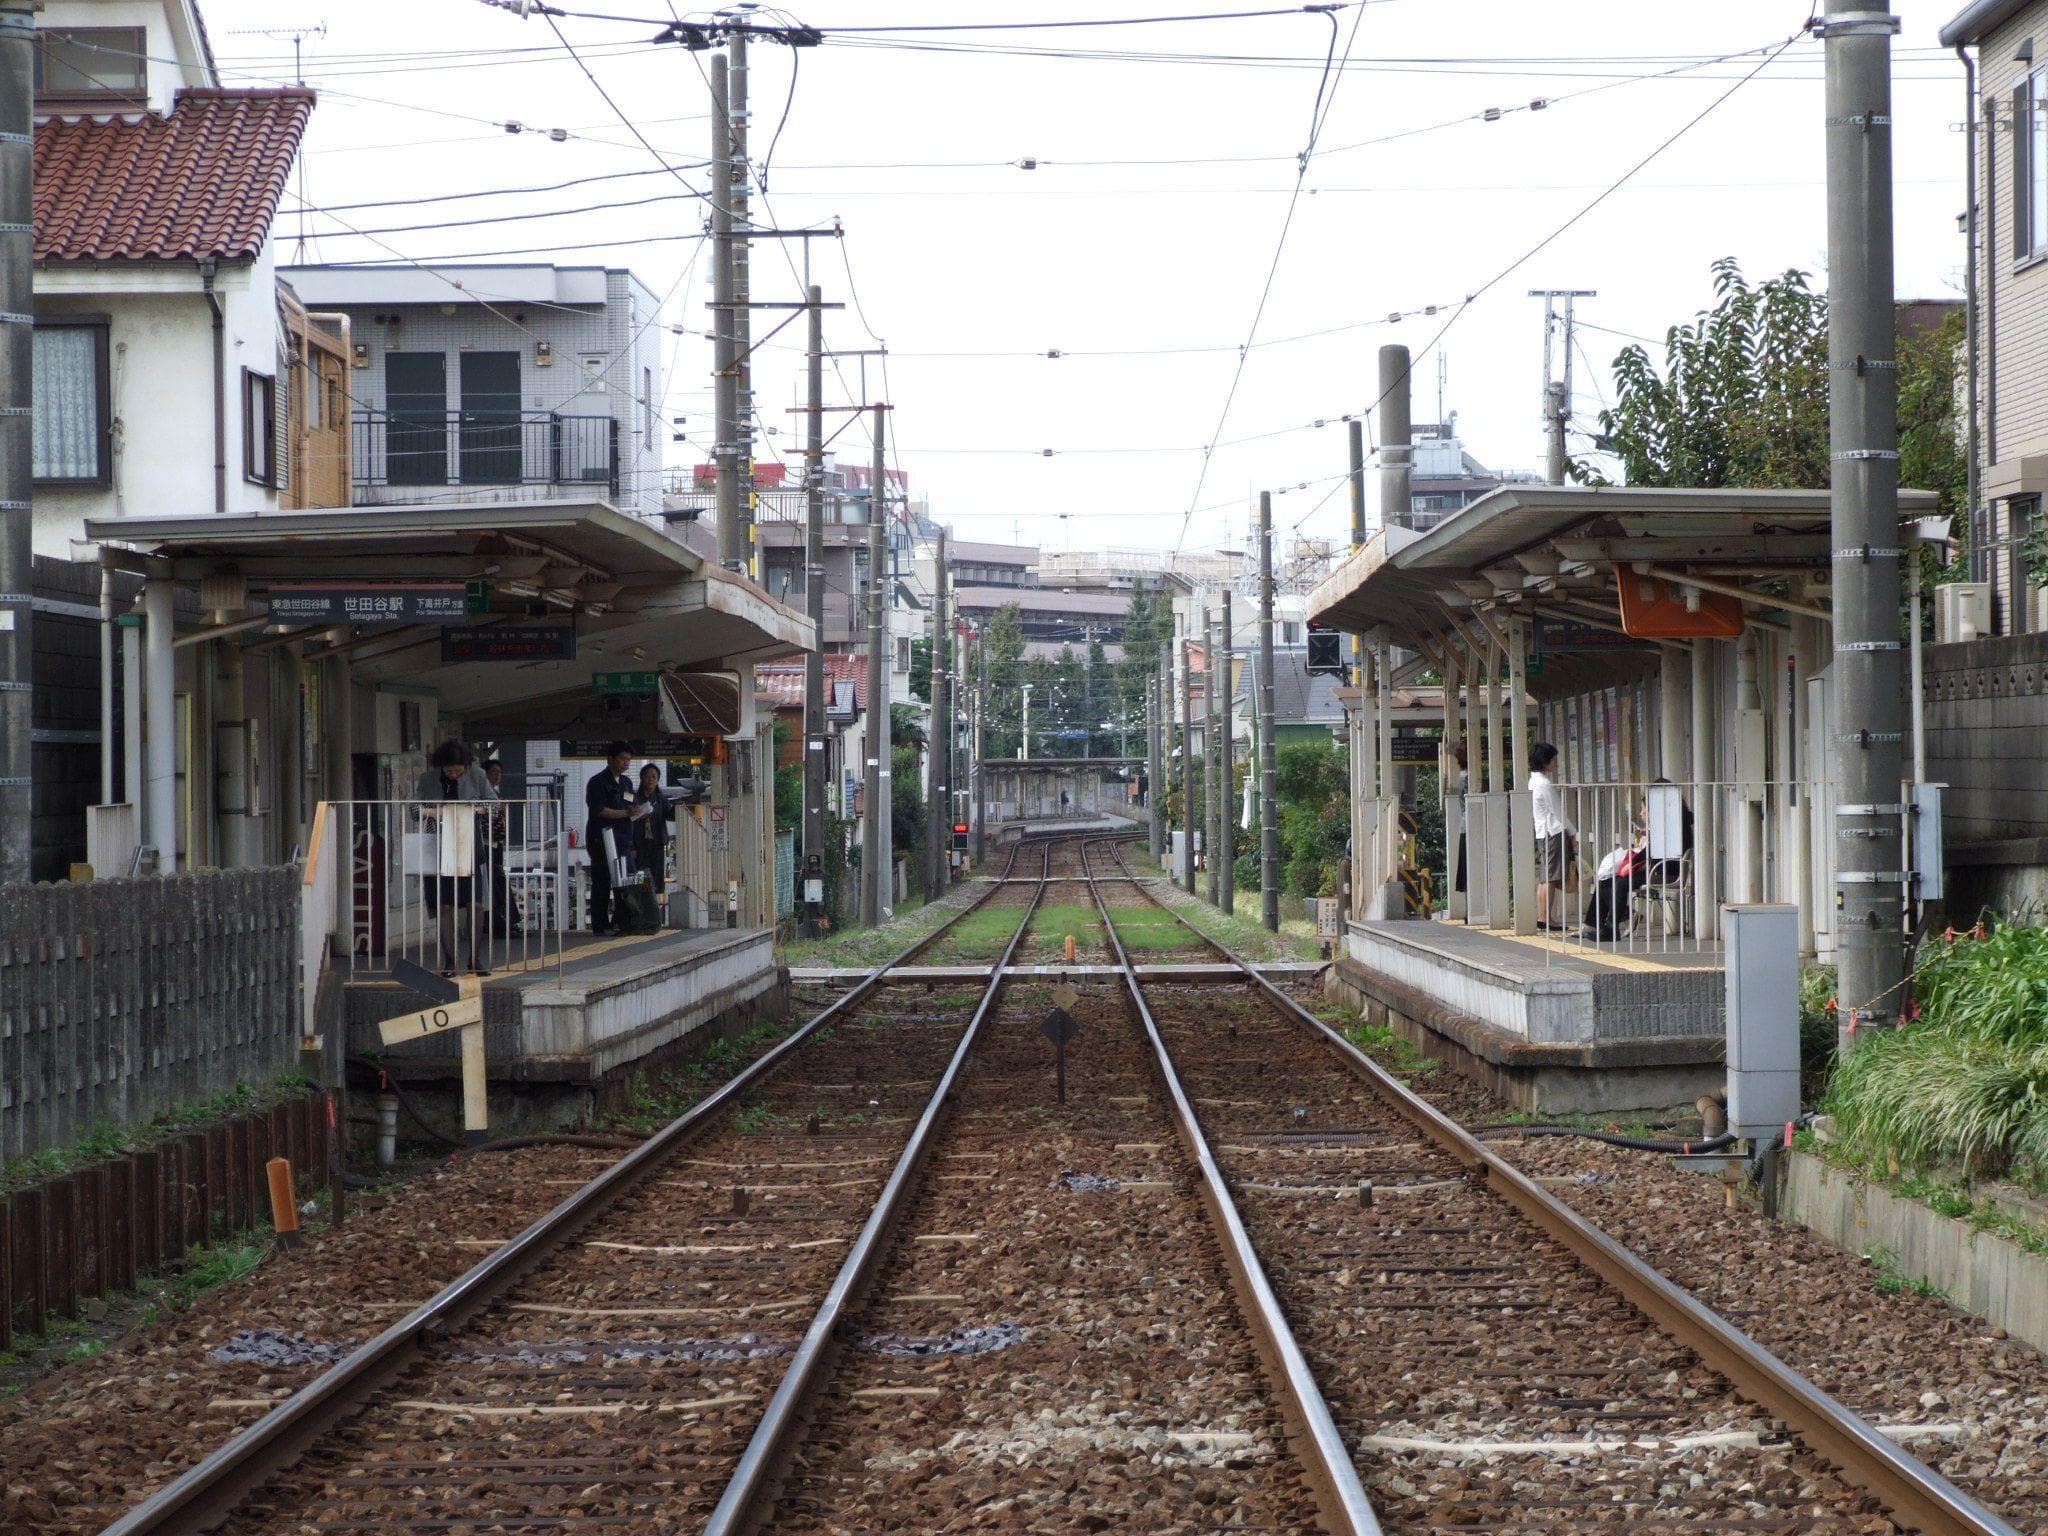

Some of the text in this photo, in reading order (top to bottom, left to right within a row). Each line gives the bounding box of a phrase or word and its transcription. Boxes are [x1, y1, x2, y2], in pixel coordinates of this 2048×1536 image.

[272, 599, 330, 610] 東急世田谷線
[344, 597, 403, 611] 世田谷駅
[350, 612, 399, 621] Setagaya Sta.
[729, 891, 737, 901] 2
[420, 1008, 449, 1033] 10
